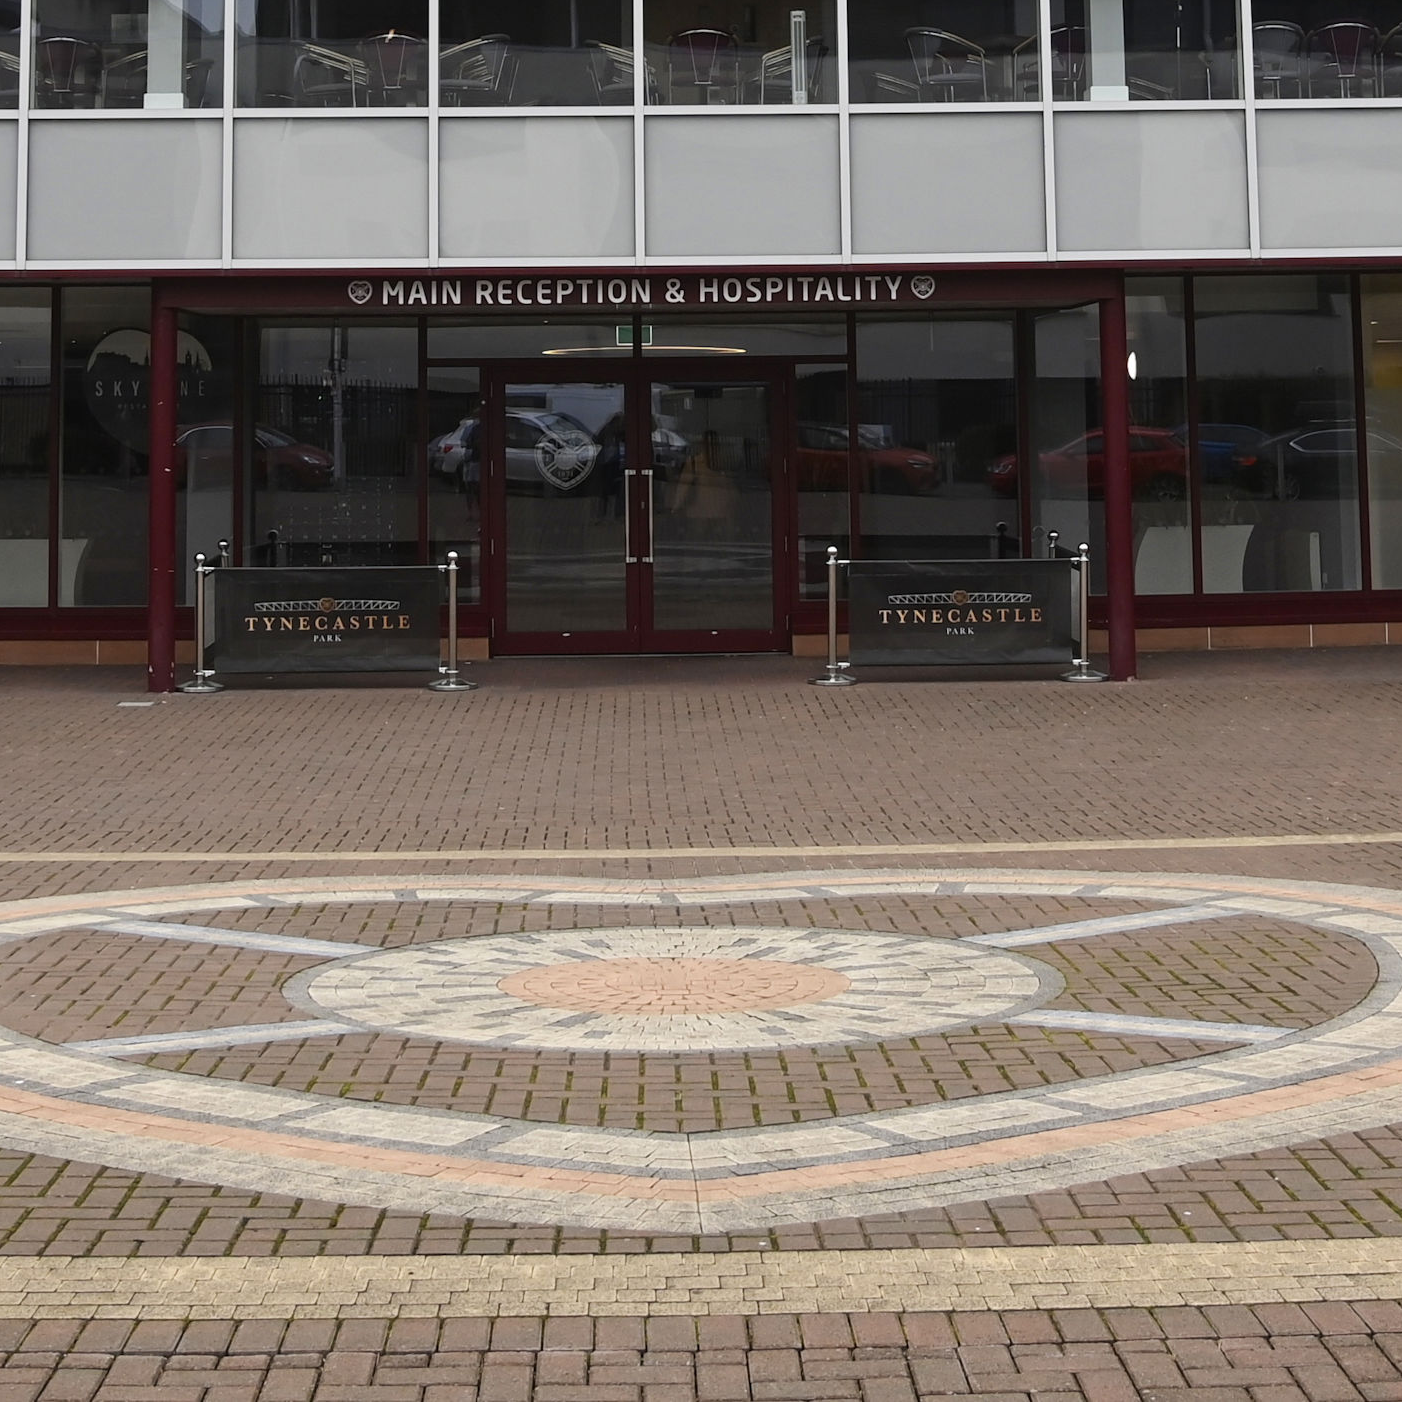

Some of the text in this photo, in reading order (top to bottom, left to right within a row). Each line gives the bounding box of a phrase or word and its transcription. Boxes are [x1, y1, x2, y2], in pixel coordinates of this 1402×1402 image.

[382, 276, 902, 305] MAIN RECEPTION & HOSPITALITY
[94, 380, 207, 397] SKYNE
[244, 615, 410, 632] TYNECASTLE
[878, 608, 1042, 624] TYNECASTLE
[313, 634, 342, 643] PARK
[946, 626, 975, 636] PARK
